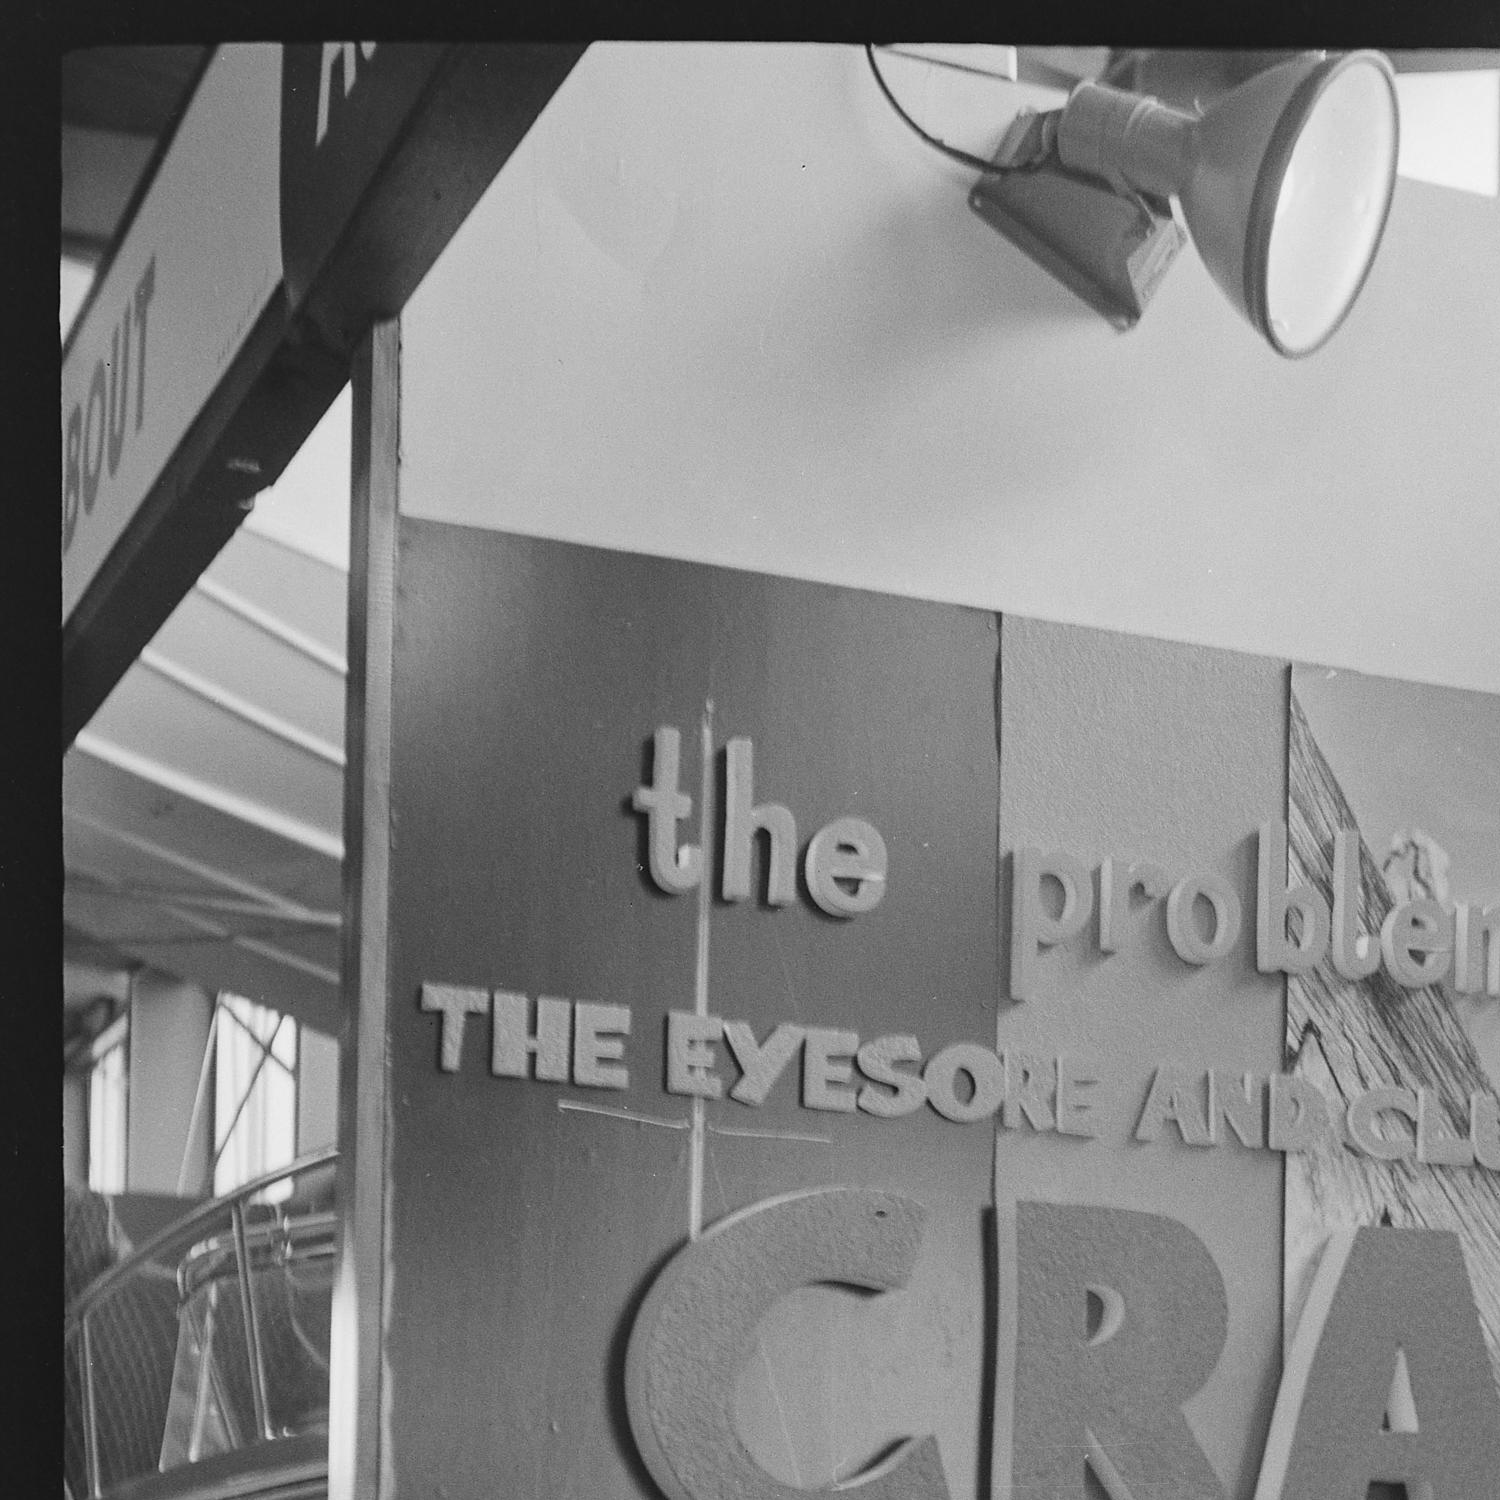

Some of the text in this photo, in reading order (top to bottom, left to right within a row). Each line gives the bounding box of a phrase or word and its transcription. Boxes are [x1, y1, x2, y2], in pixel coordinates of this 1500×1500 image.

[632, 726, 888, 918] the
[421, 980, 632, 1089] THE
[665, 1007, 1098, 1140] EYESORE
[1135, 1062, 1327, 1152] AND
